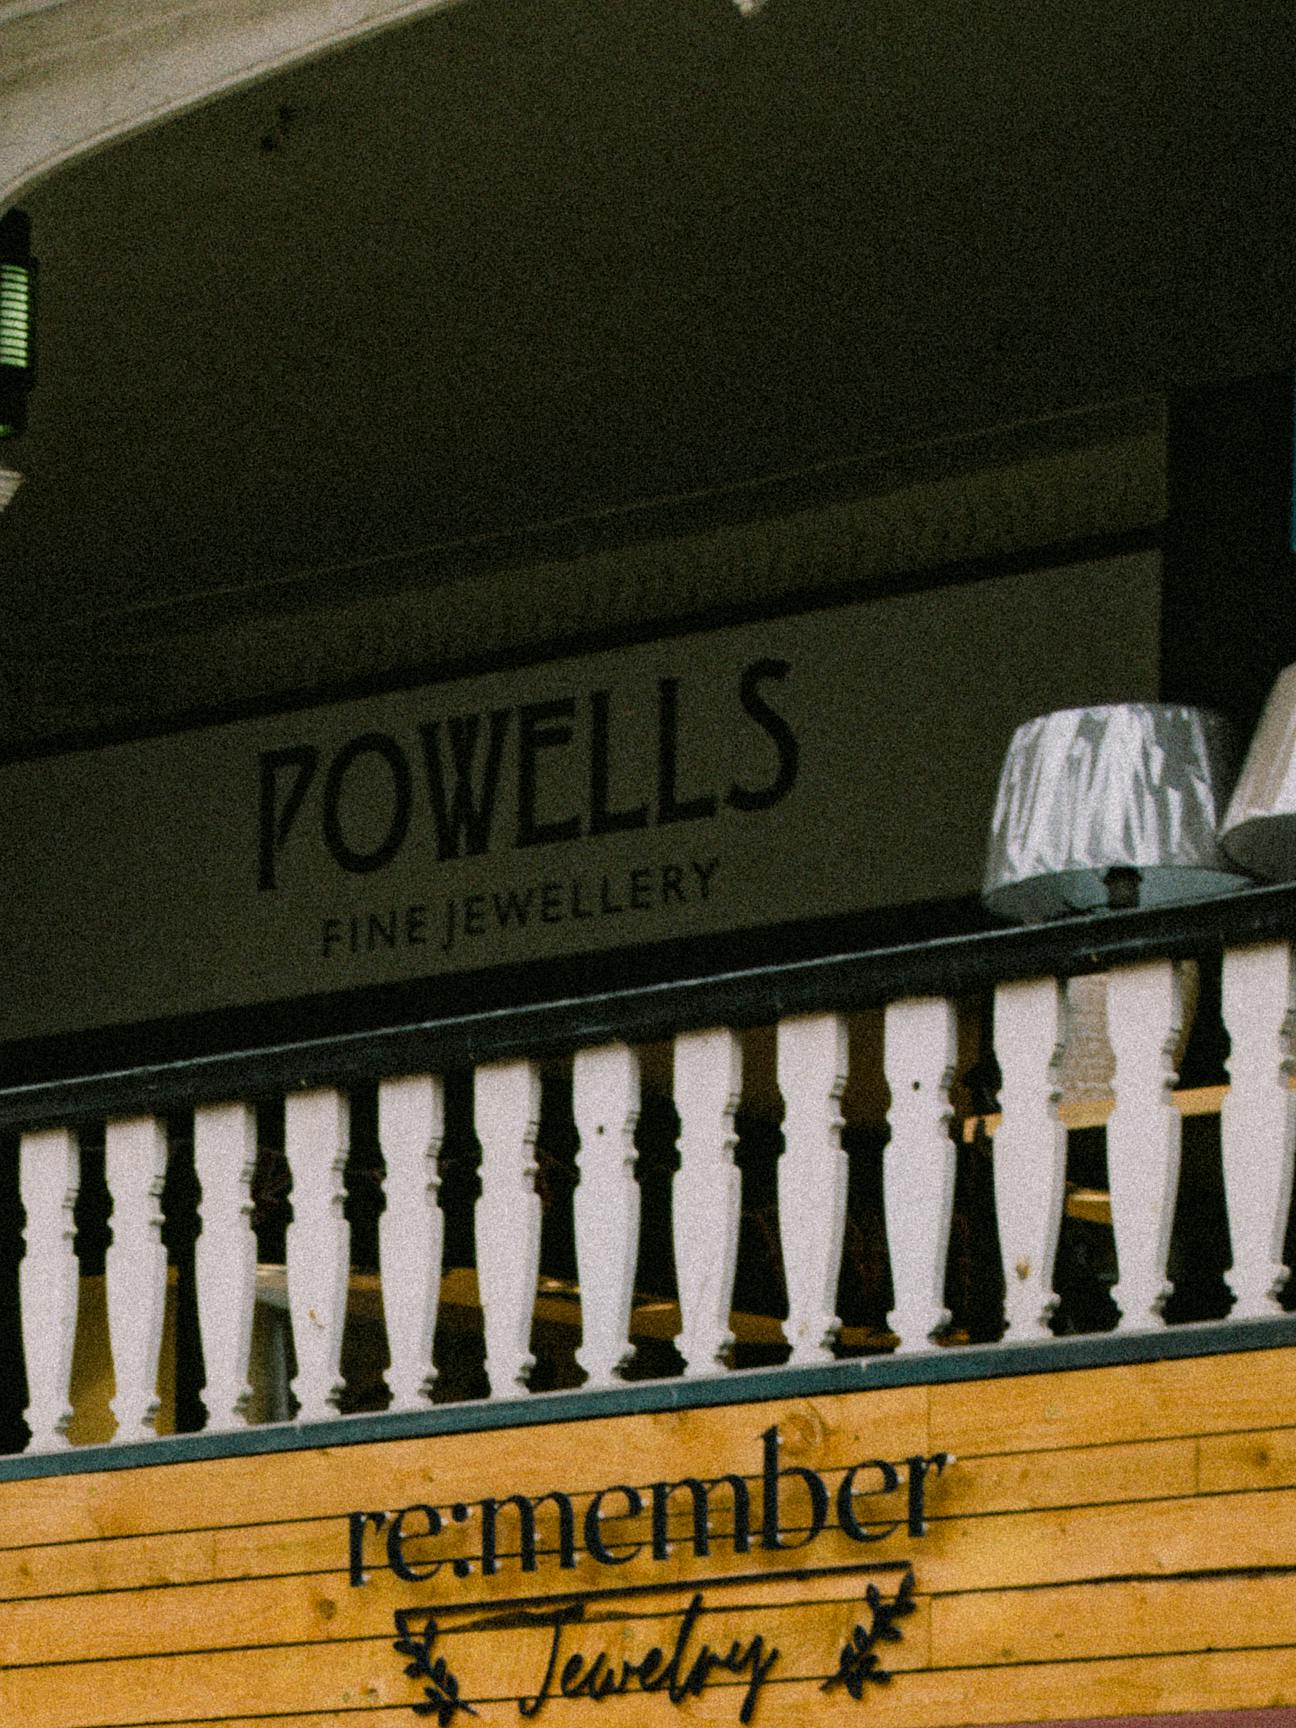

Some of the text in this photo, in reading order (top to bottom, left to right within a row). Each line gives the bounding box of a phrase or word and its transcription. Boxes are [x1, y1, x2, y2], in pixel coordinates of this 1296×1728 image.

[258, 657, 800, 891] POWELLS
[321, 857, 720, 957] FINE JEWELLERY
[349, 1424, 950, 1588] re:member
[516, 1592, 780, 1725] Jewelry
